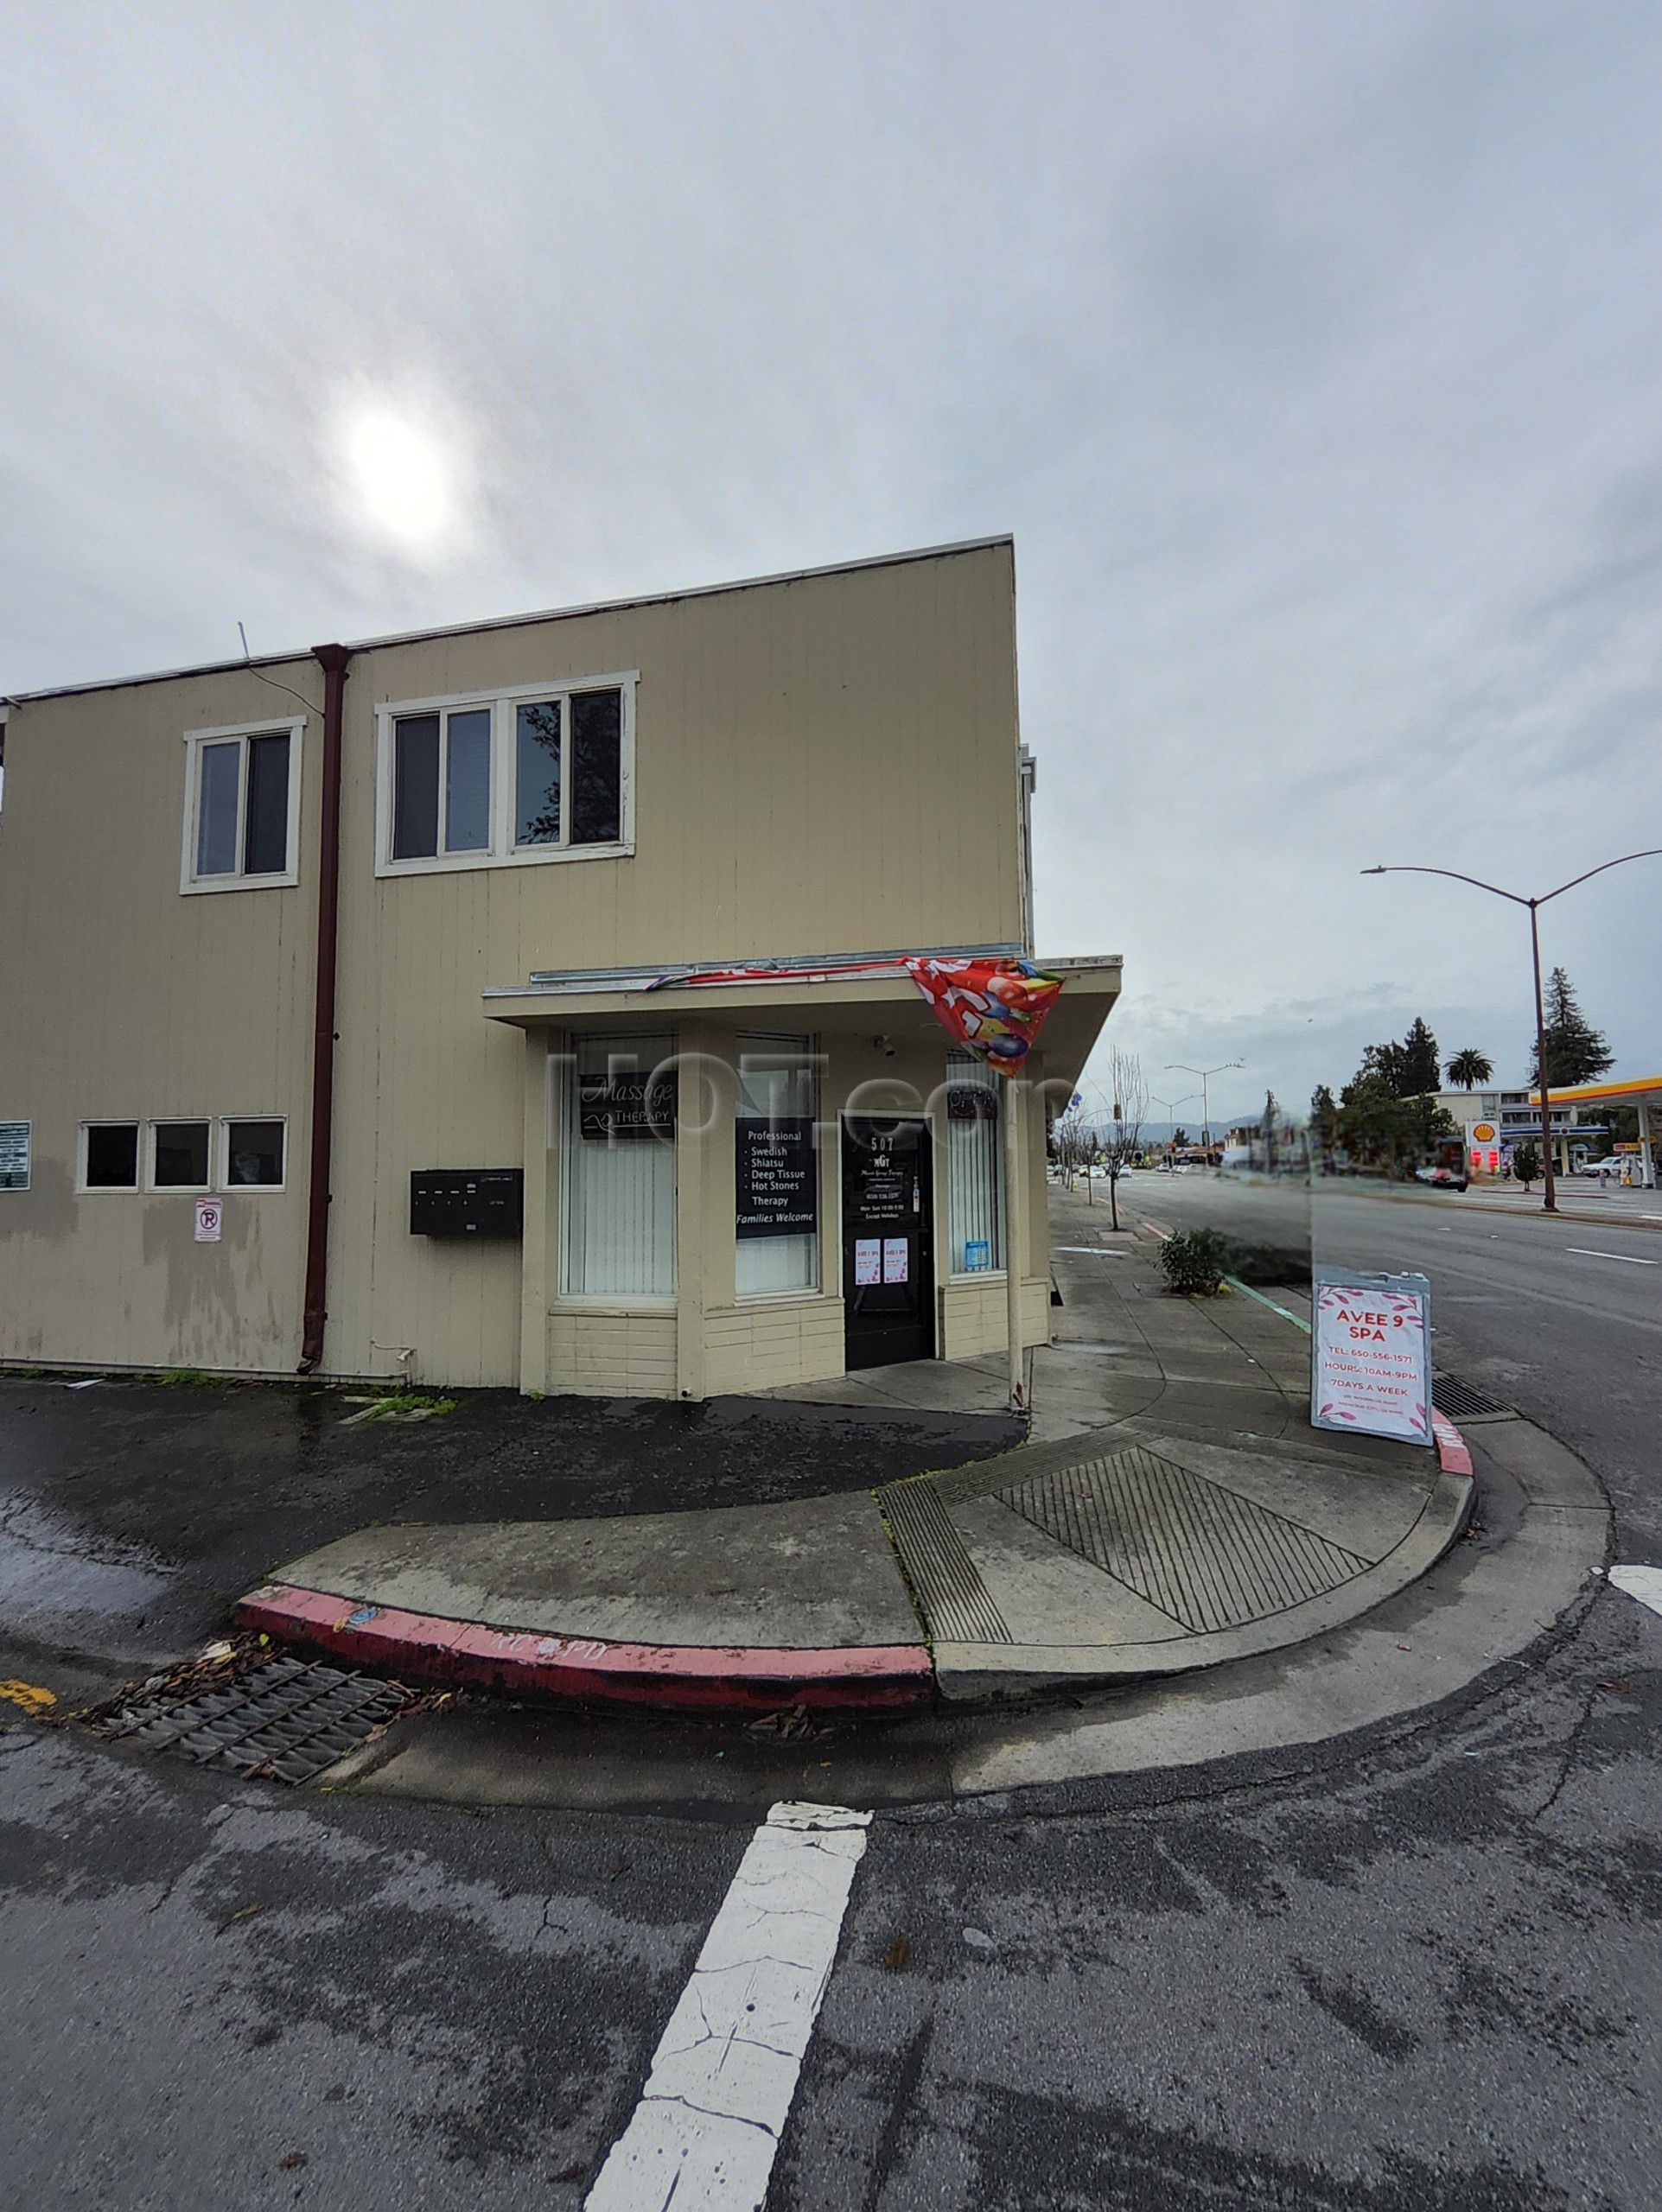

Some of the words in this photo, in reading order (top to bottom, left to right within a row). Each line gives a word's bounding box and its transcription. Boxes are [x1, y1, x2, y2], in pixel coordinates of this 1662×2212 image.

[582, 1077, 673, 1107] Massage
[614, 1109, 670, 1123] THERAPY
[748, 1130, 802, 1141] Professional
[871, 1137, 894, 1151] 507
[751, 1147, 787, 1157] Swedish
[751, 1158, 784, 1168] Shiatsu
[751, 1169, 775, 1180] Deep
[777, 1168, 806, 1179] Tissue
[751, 1181, 768, 1191] Hot
[770, 1180, 799, 1191] Stones
[752, 1196, 788, 1207] Therapy
[735, 1214, 774, 1224] Families
[776, 1211, 814, 1223] Welcome
[1336, 1309, 1388, 1326] AVEE
[1392, 1314, 1404, 1327] 9
[1349, 1326, 1386, 1342] SPA
[1351, 1349, 1413, 1363] 650-556-1571
[1325, 1361, 1362, 1373] HOURS:
[1365, 1367, 1417, 1381] 10AM-9PM
[1377, 1385, 1408, 1396] WEEK
